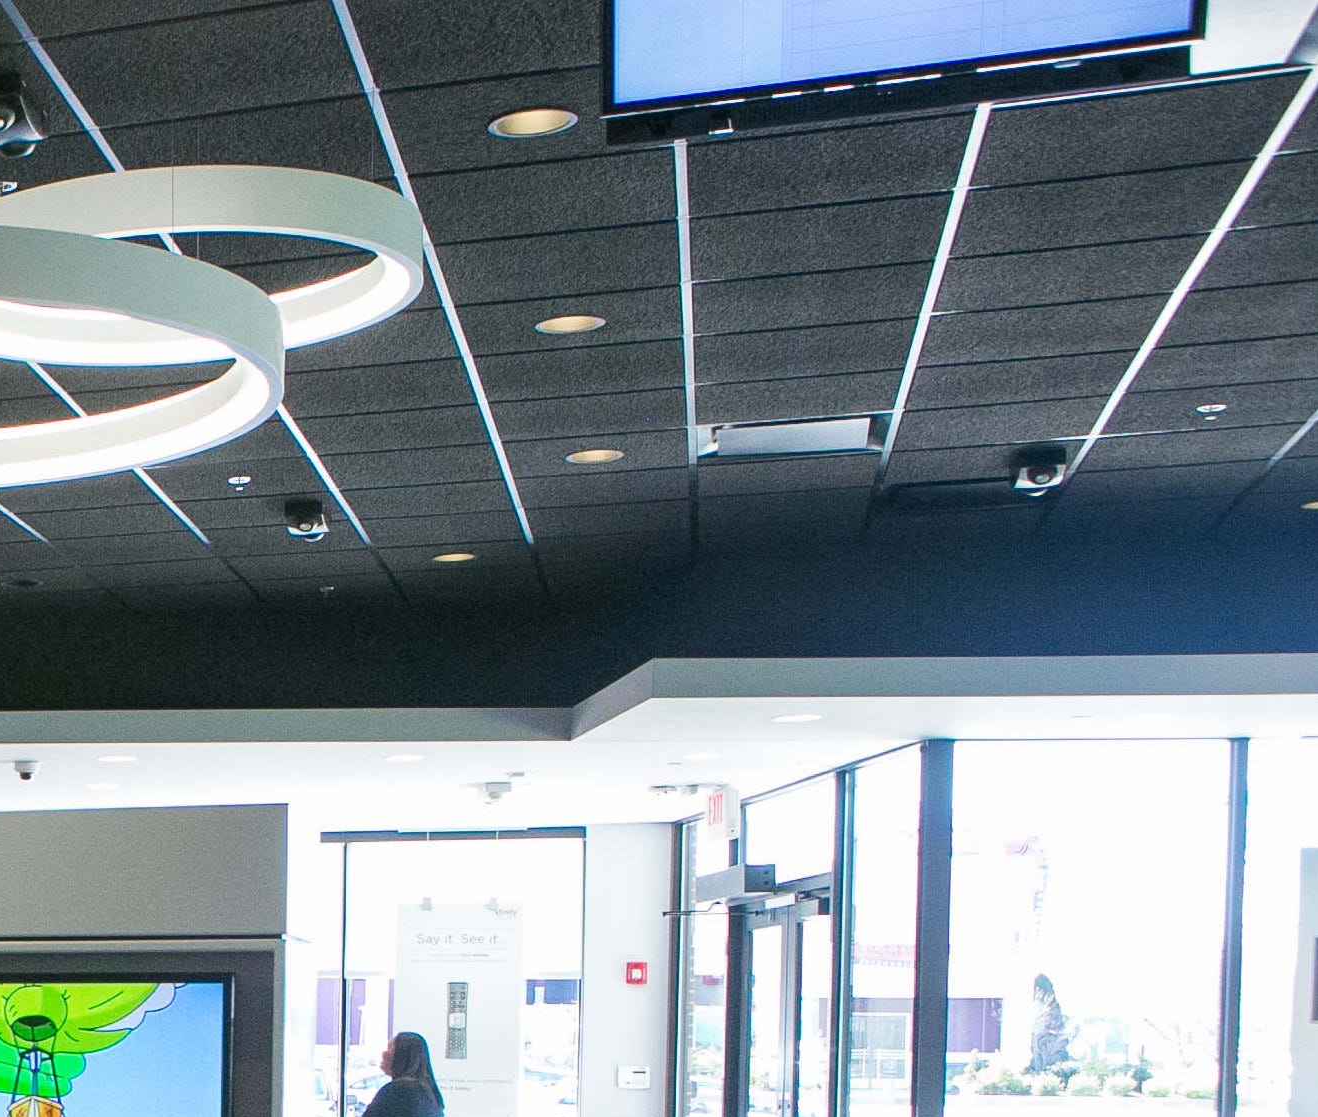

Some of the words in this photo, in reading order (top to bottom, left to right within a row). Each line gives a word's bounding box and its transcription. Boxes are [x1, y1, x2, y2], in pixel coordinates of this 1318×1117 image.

[708, 794, 723, 826] EXIT
[417, 933, 440, 945] Say
[461, 933, 484, 944] See
